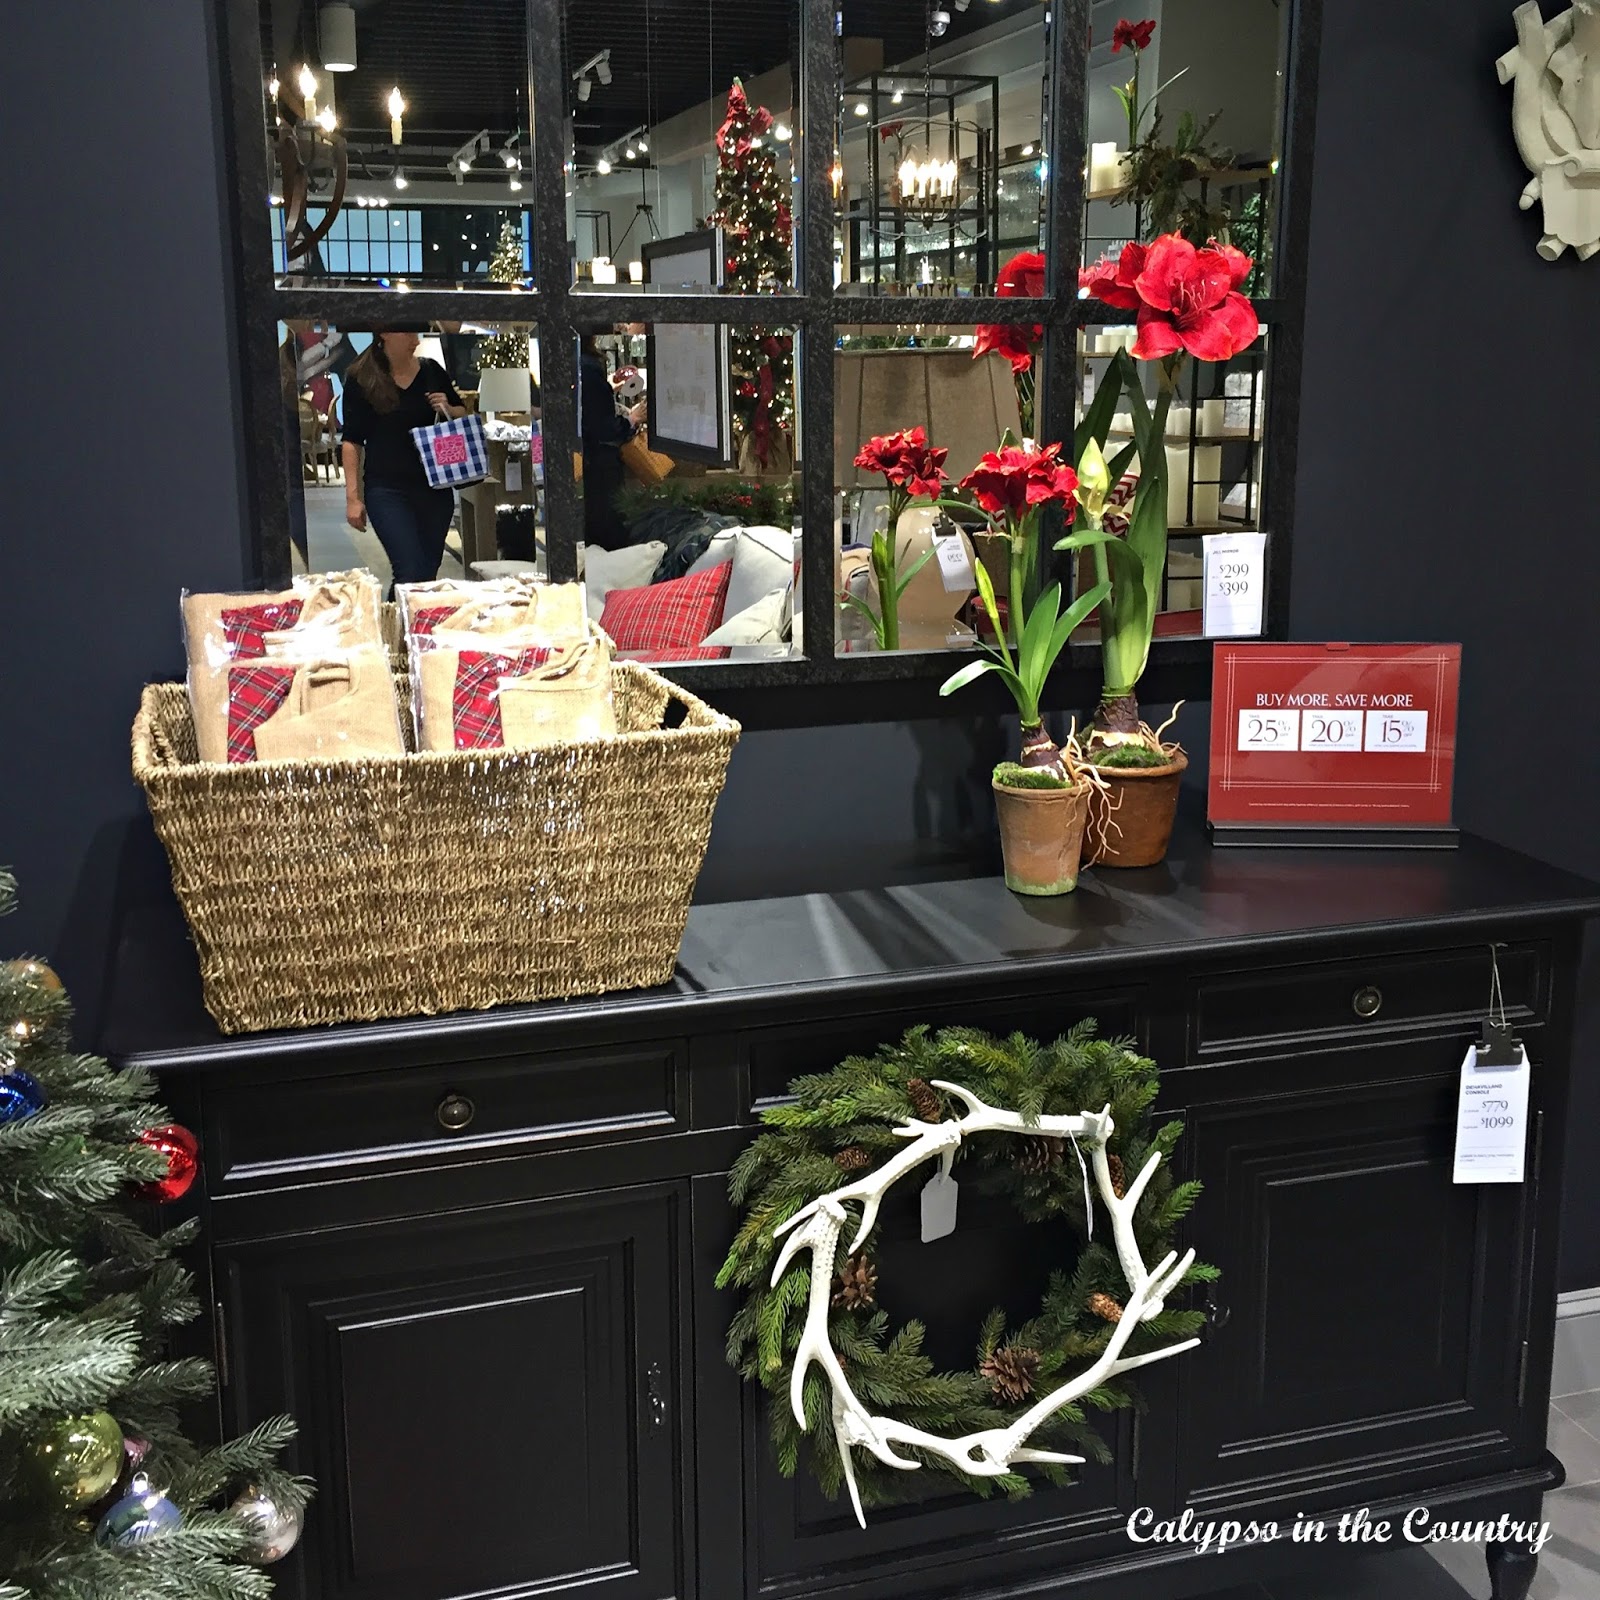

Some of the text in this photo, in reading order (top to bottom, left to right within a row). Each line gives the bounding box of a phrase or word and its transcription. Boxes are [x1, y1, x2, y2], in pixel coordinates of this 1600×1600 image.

[1219, 563, 1249, 578] $299
[1219, 581, 1249, 596] $399
[1256, 693, 1284, 706] BUY
[1335, 693, 1368, 707] SAVE
[1371, 693, 1413, 707] MORE
[1482, 1100, 1509, 1113] $779
[1481, 1116, 1514, 1129] $1099
